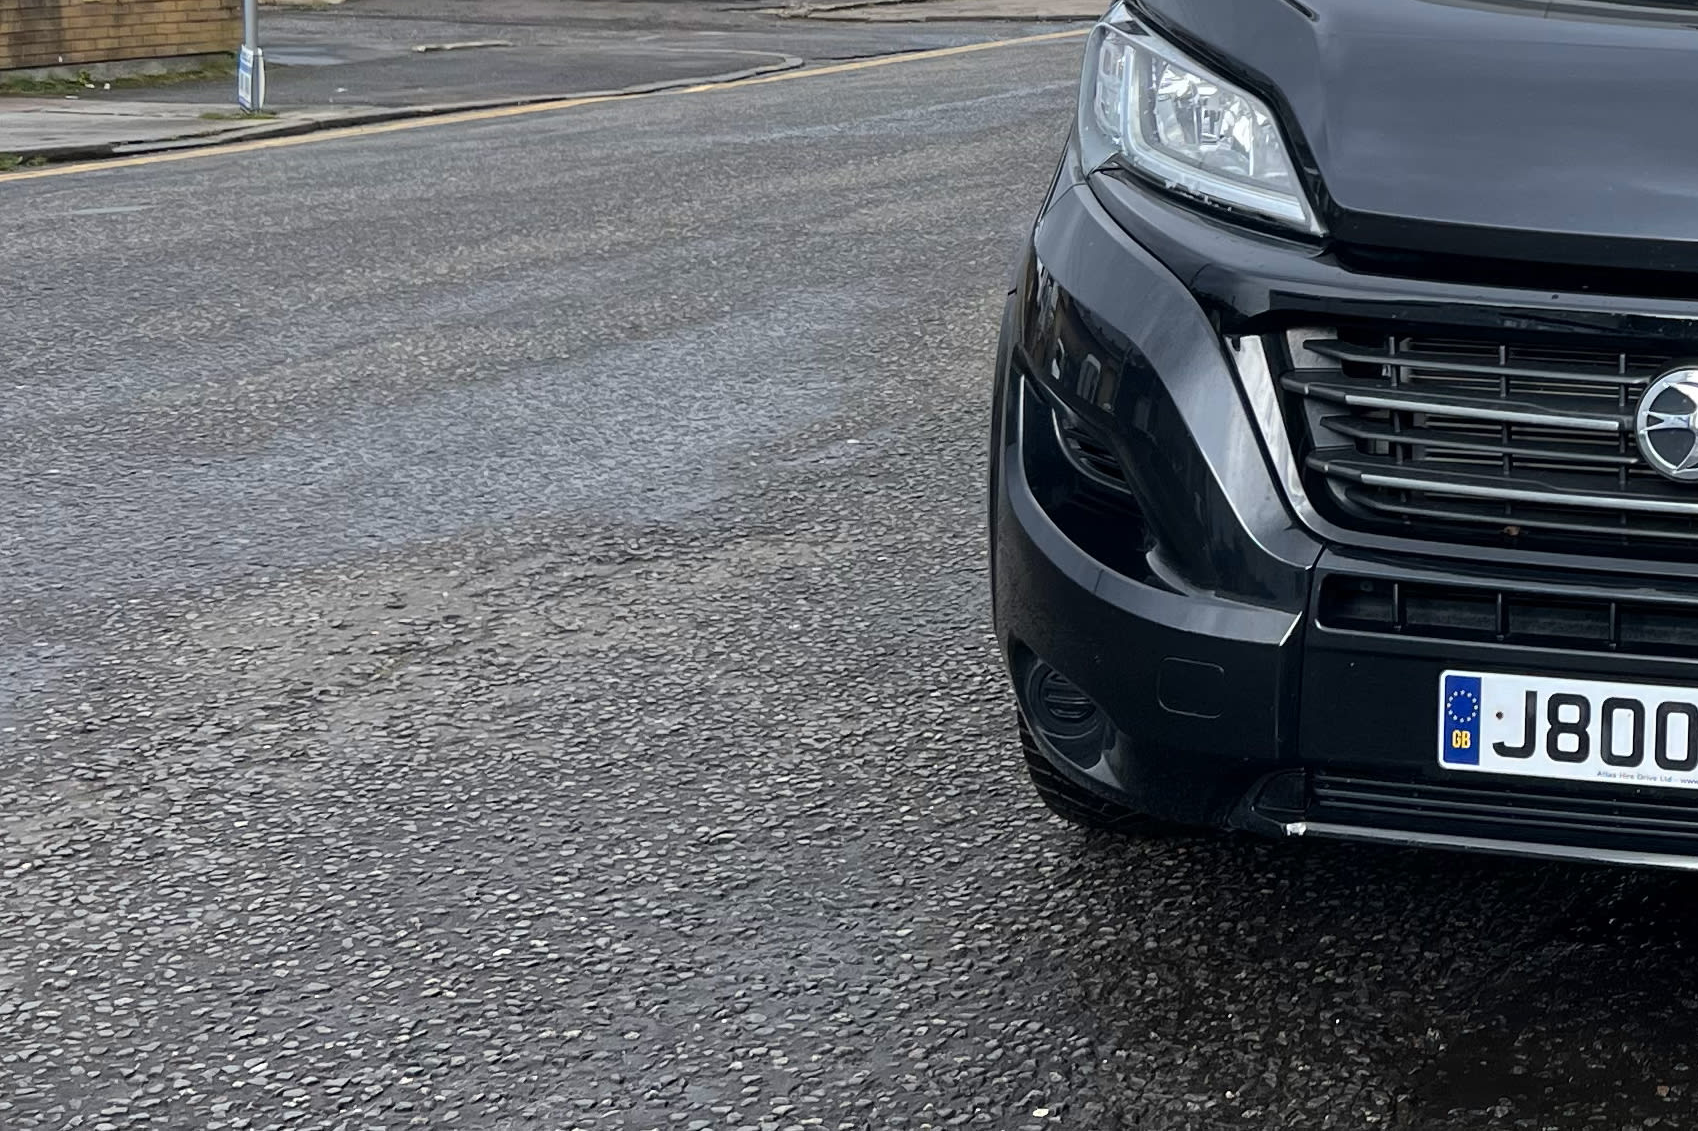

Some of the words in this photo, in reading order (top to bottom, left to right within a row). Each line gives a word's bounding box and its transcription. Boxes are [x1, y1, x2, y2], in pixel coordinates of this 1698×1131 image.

[1452, 729, 1471, 748] GB
[1597, 771, 1616, 779] Atlas
[1619, 772, 1635, 780] Hire
[1637, 773, 1657, 782] Drive
[1660, 775, 1672, 783] Ltd
